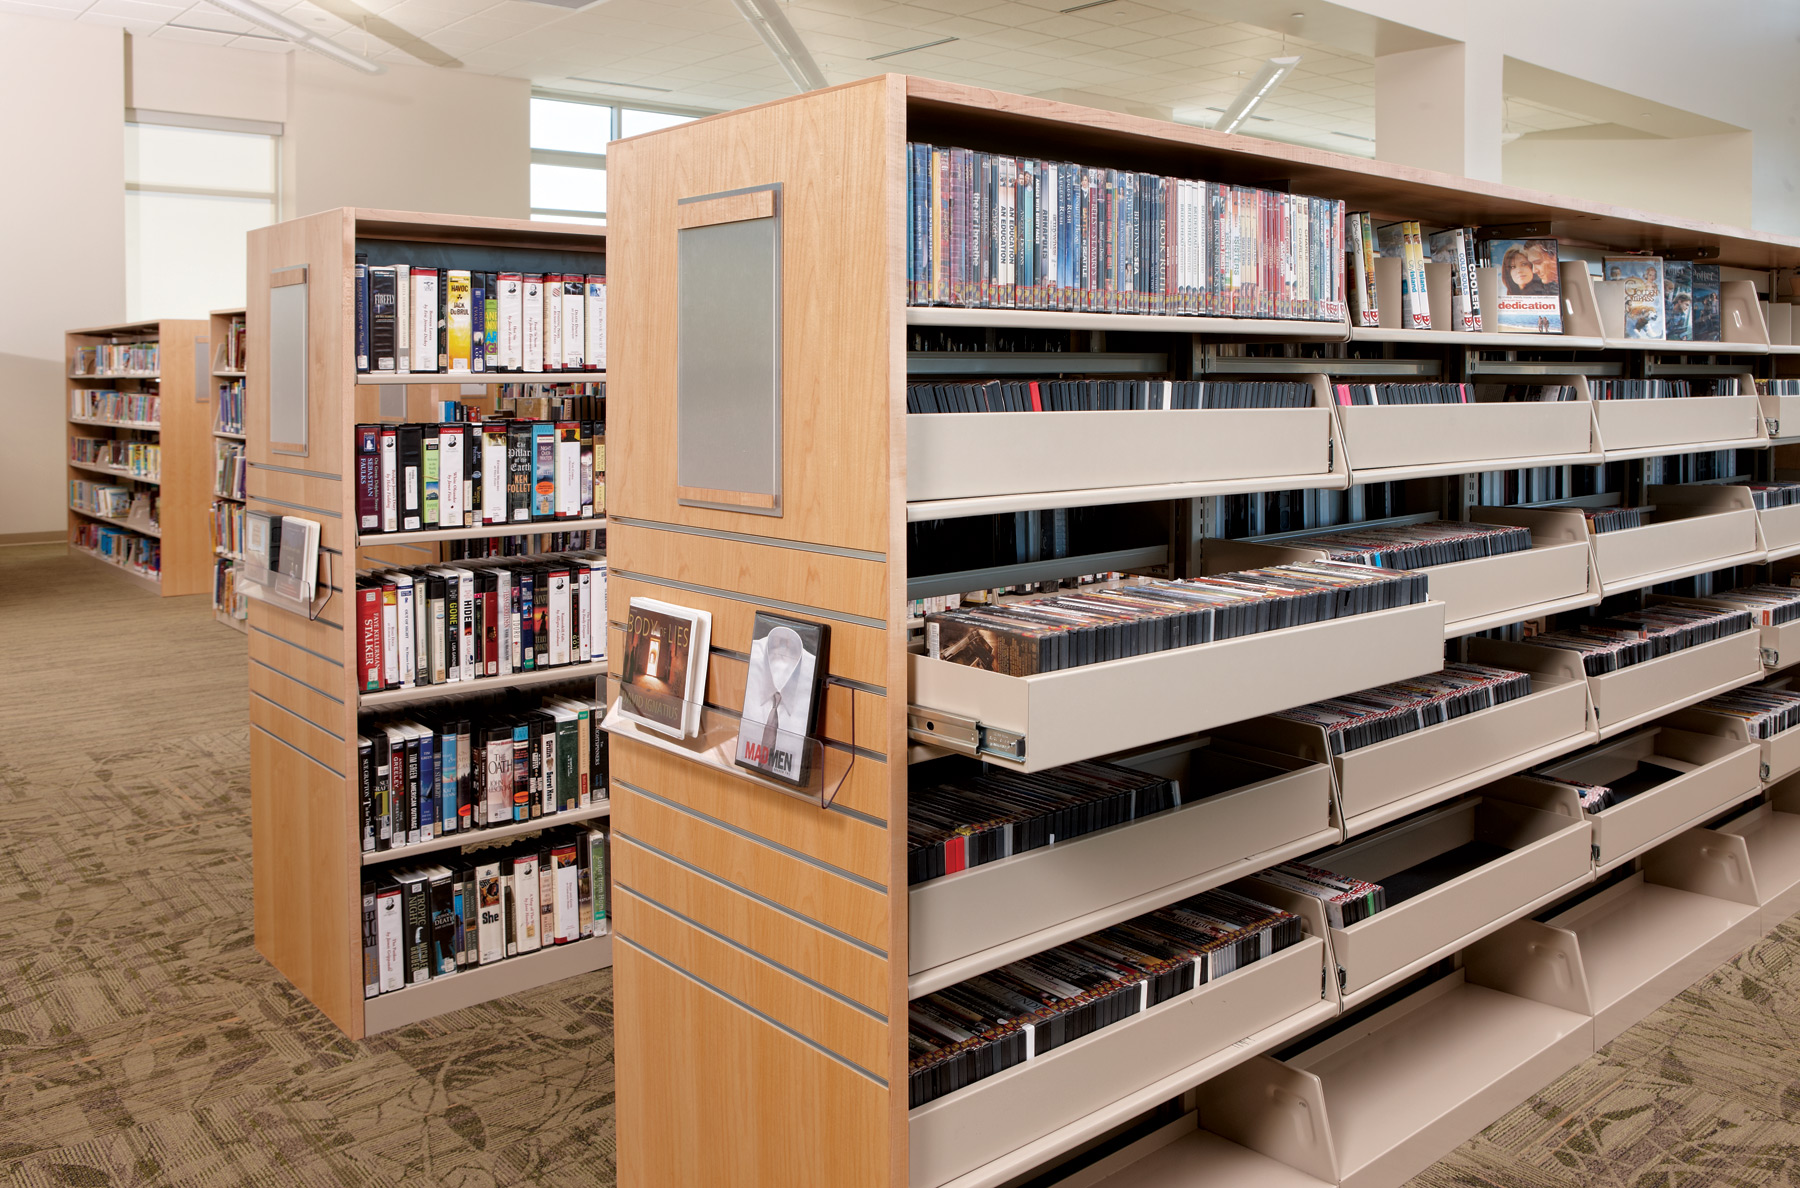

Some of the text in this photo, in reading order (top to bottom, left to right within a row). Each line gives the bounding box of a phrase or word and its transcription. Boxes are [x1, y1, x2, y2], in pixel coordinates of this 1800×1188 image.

[1001, 206, 1006, 217] AN
[1009, 207, 1014, 218] AN
[451, 285, 468, 293] HAVOC
[1468, 263, 1479, 309] COOLER
[1498, 301, 1556, 310] dedication
[508, 449, 531, 458] Pillar
[507, 484, 531, 493] FOLLET
[449, 602, 457, 624] GONE
[464, 600, 472, 622] HIDE
[627, 613, 689, 648] BODY OF LIES
[364, 619, 374, 665] STALKER
[621, 690, 678, 721] DAVID IGNATIUS
[409, 753, 417, 779] TIM GREEN
[489, 759, 512, 774] OATH
[408, 896, 418, 926] NIGHT
[417, 892, 426, 926] TROPIC
[482, 911, 499, 924] She
[411, 946, 420, 972] GRUBER
